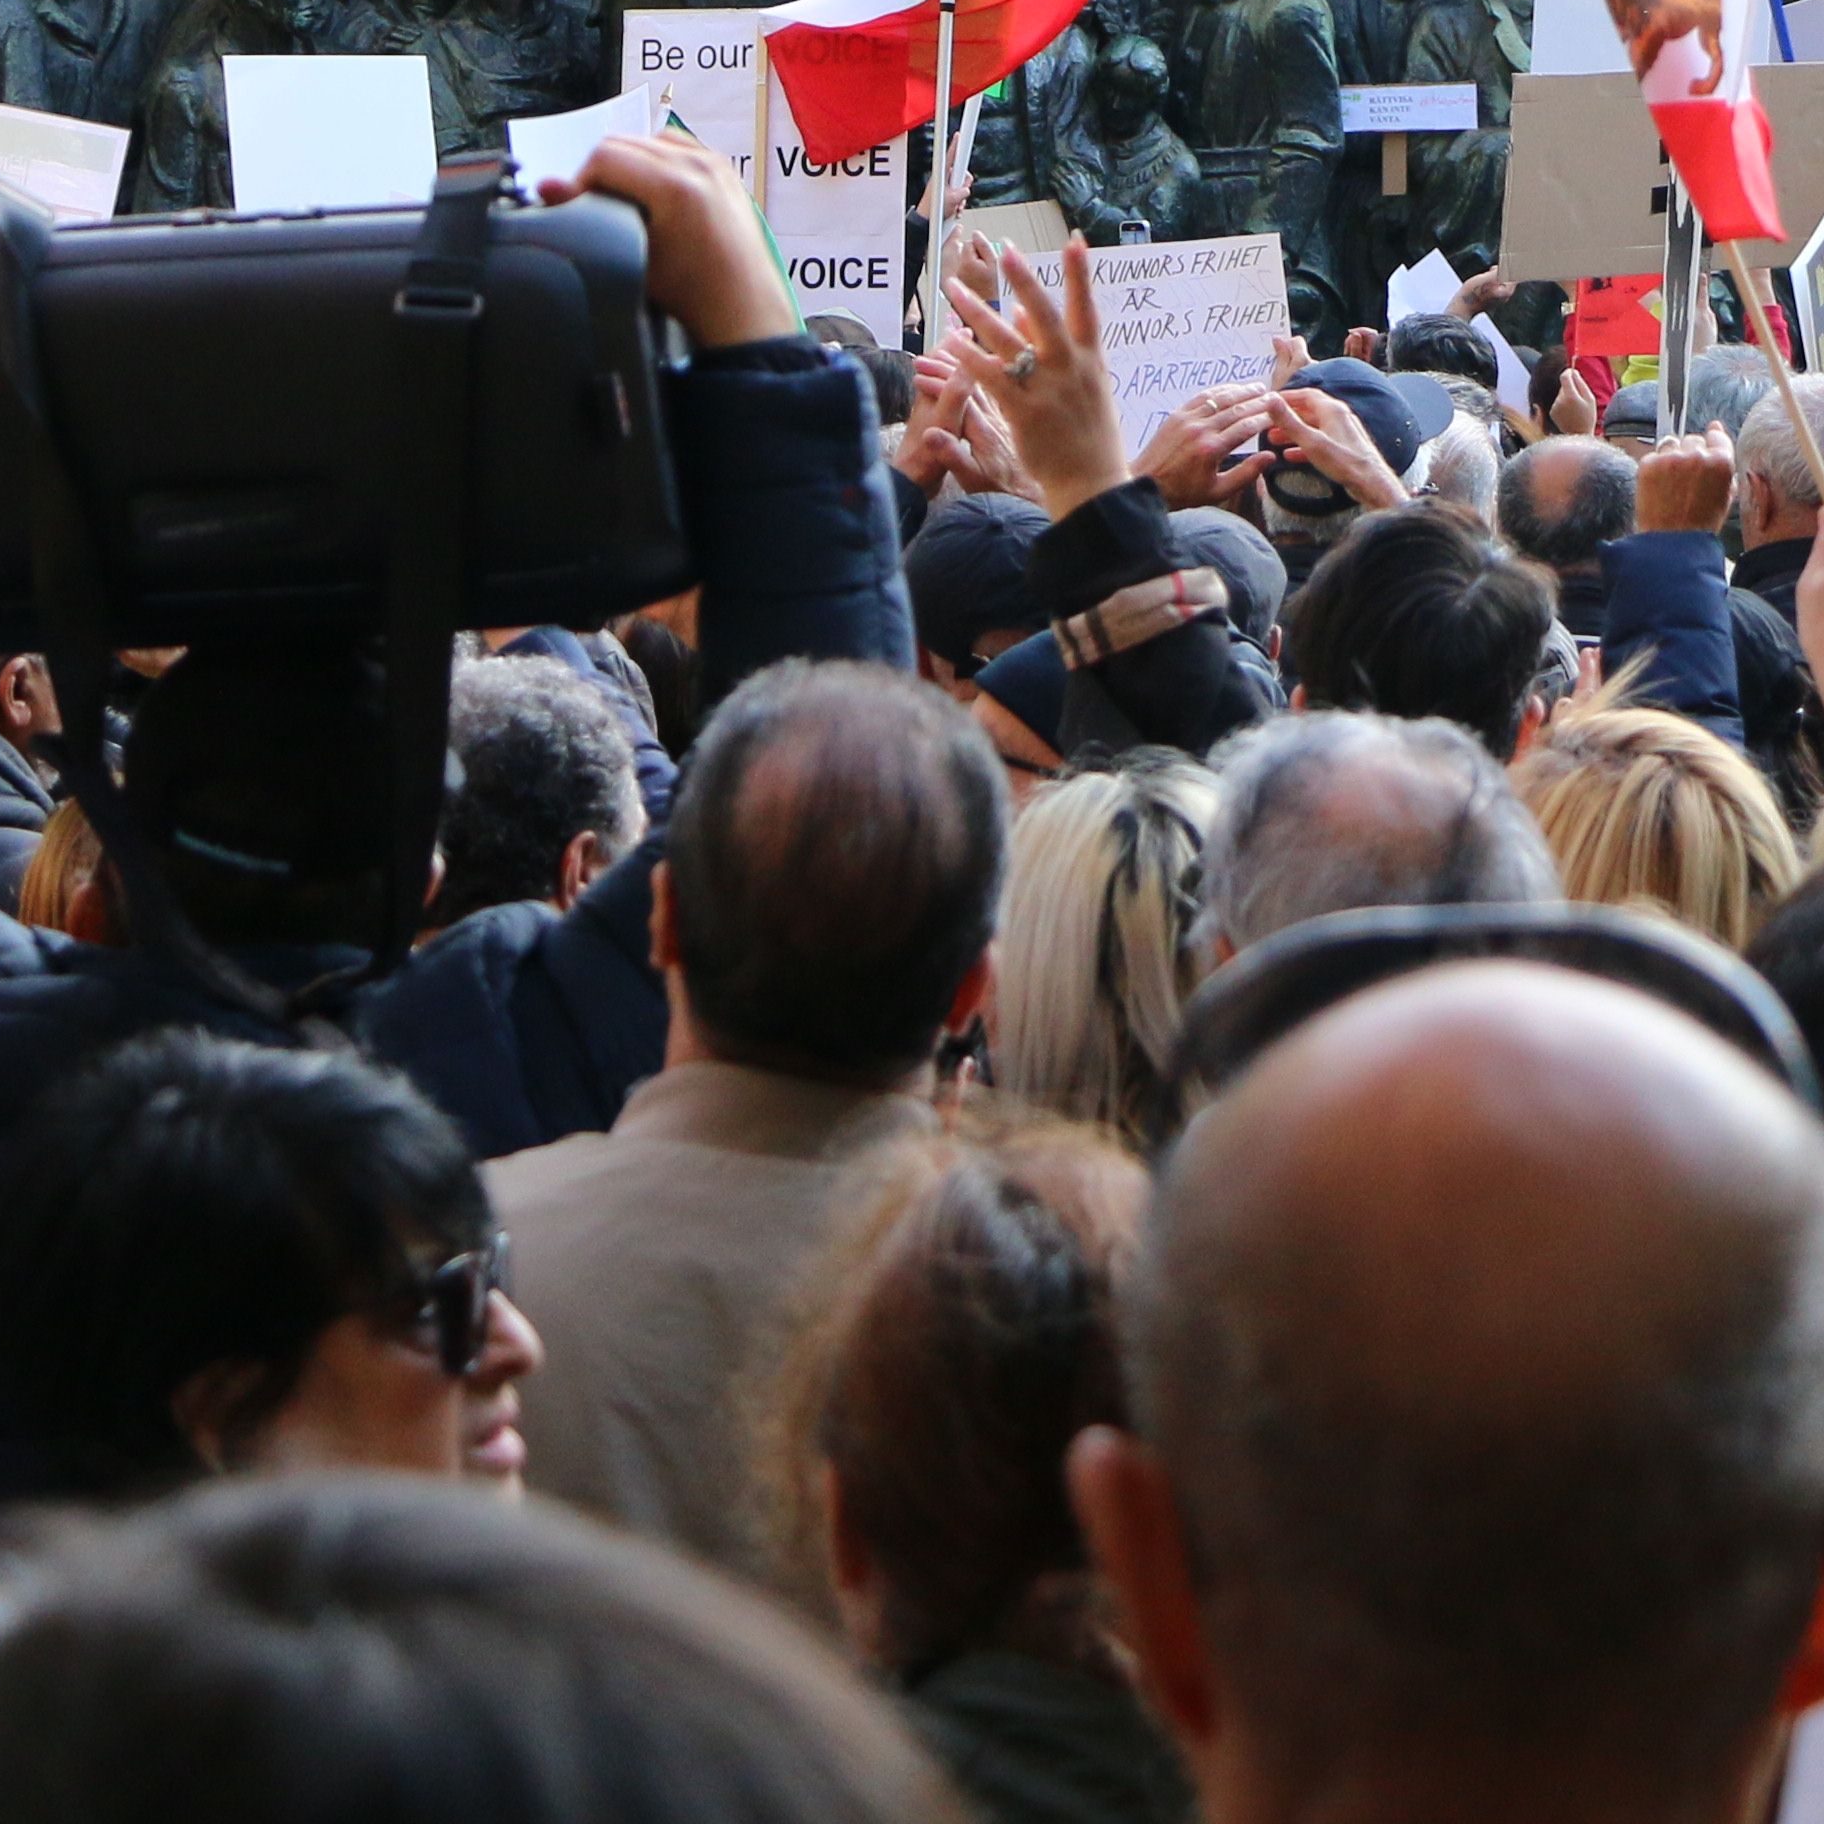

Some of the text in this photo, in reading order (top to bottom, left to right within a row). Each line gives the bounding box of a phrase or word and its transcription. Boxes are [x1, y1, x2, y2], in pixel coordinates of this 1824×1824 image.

[641, 33, 893, 70] Be our VOICE
[1190, 245, 1268, 274] FRIHET
